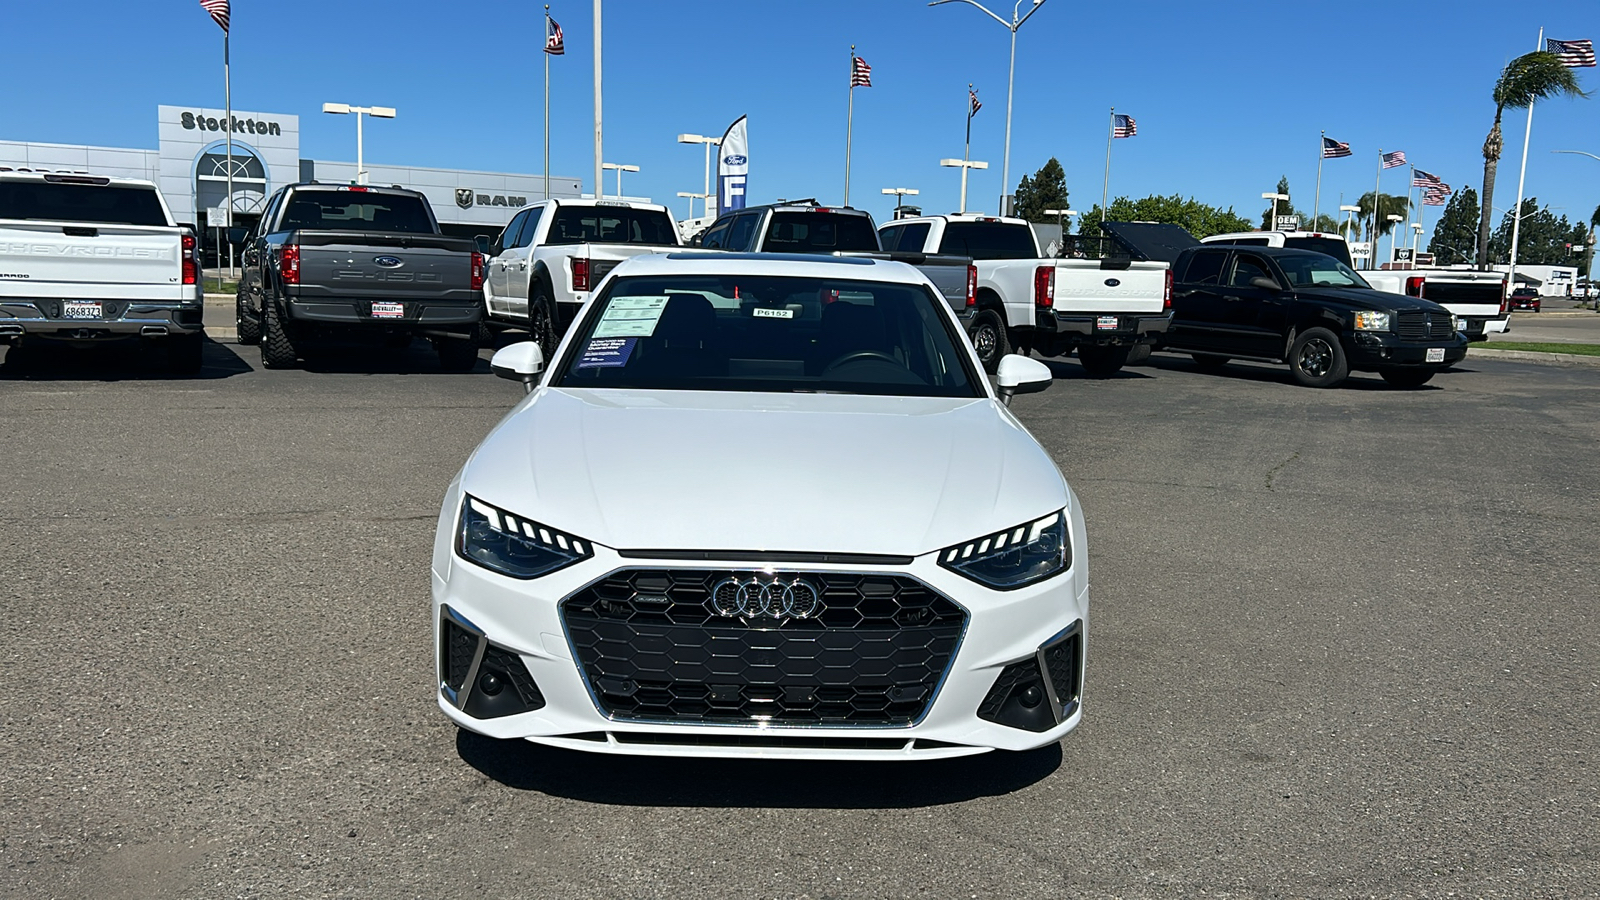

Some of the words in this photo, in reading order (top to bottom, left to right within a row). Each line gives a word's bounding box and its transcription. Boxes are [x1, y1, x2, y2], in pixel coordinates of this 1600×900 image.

[181, 112, 281, 136] Stockton
[727, 156, 745, 165] Ford
[476, 194, 527, 207] RAM
[1277, 216, 1297, 224] OEM
[1351, 247, 1370, 256] Jeep
